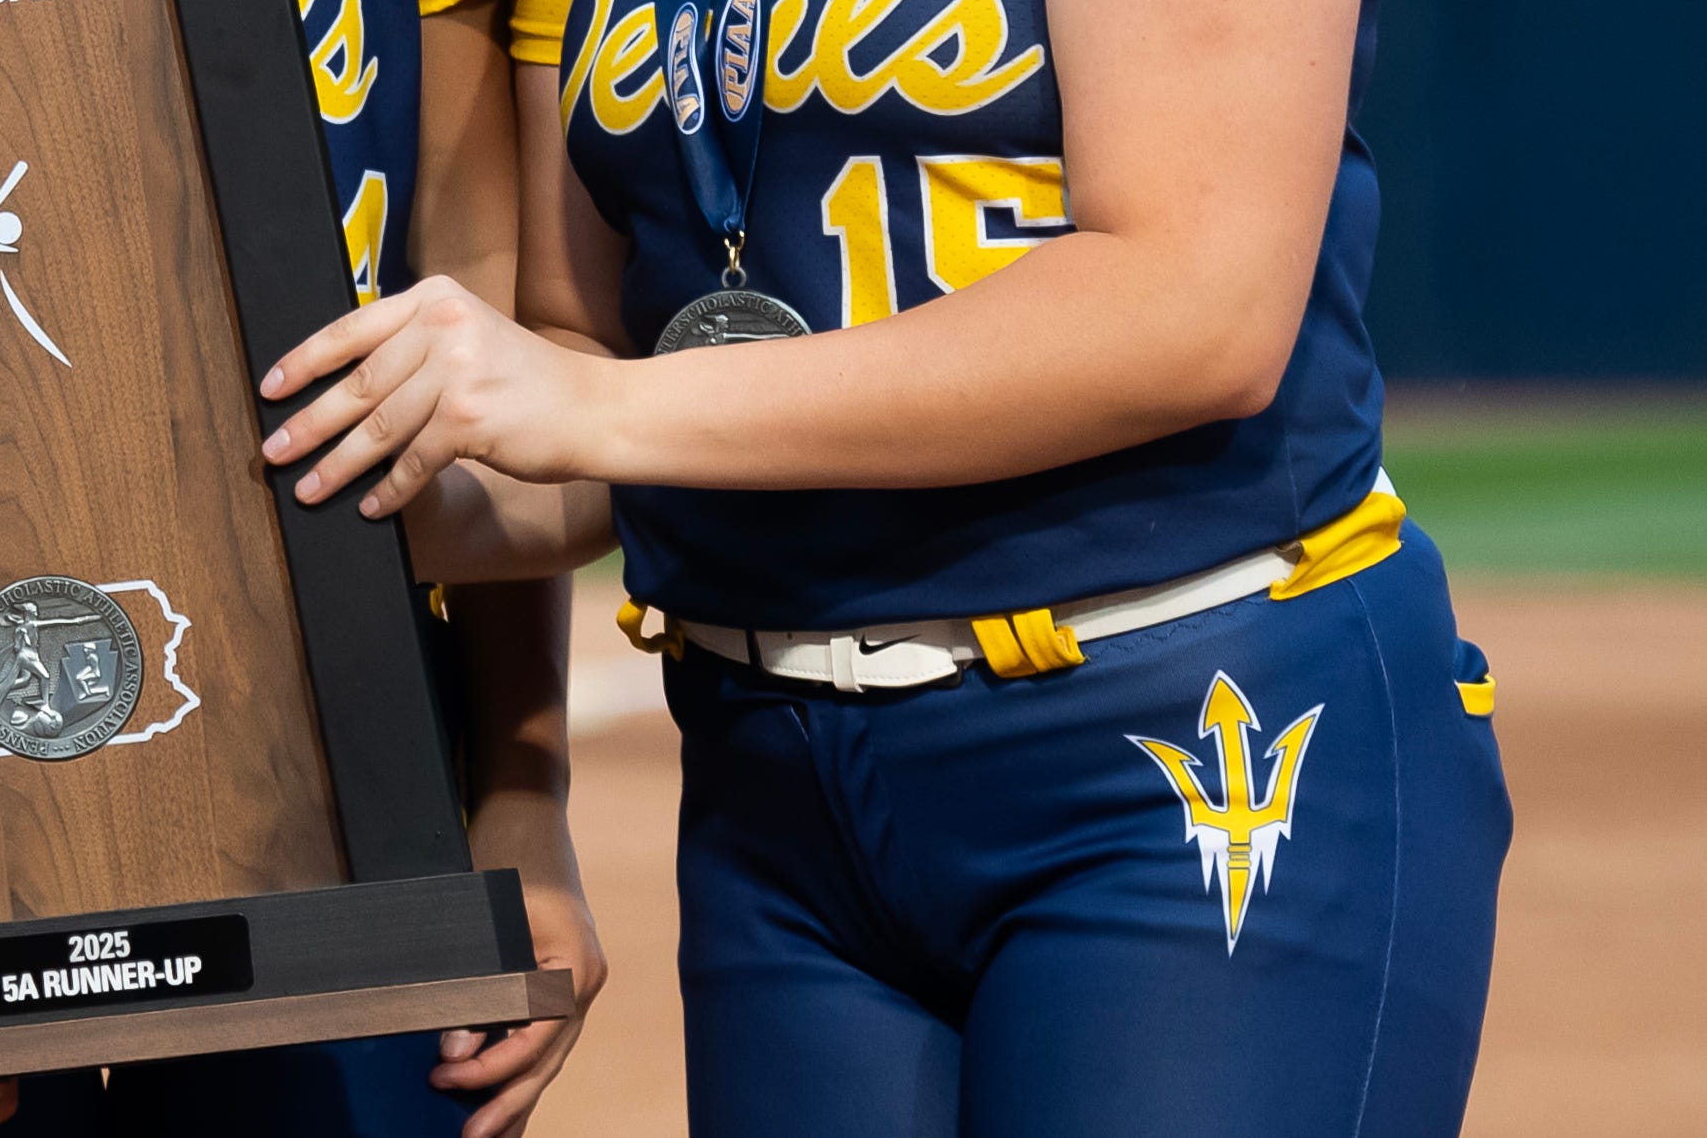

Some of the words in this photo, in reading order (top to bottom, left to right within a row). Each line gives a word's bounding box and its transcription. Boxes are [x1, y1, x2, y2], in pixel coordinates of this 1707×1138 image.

[83, 590, 138, 659] ATHLETIC
[74, 660, 140, 750] ASSOCIATION
[68, 930, 131, 963] 2025
[1, 972, 40, 1003] 5A
[42, 955, 203, 999] RUNNER-UP
